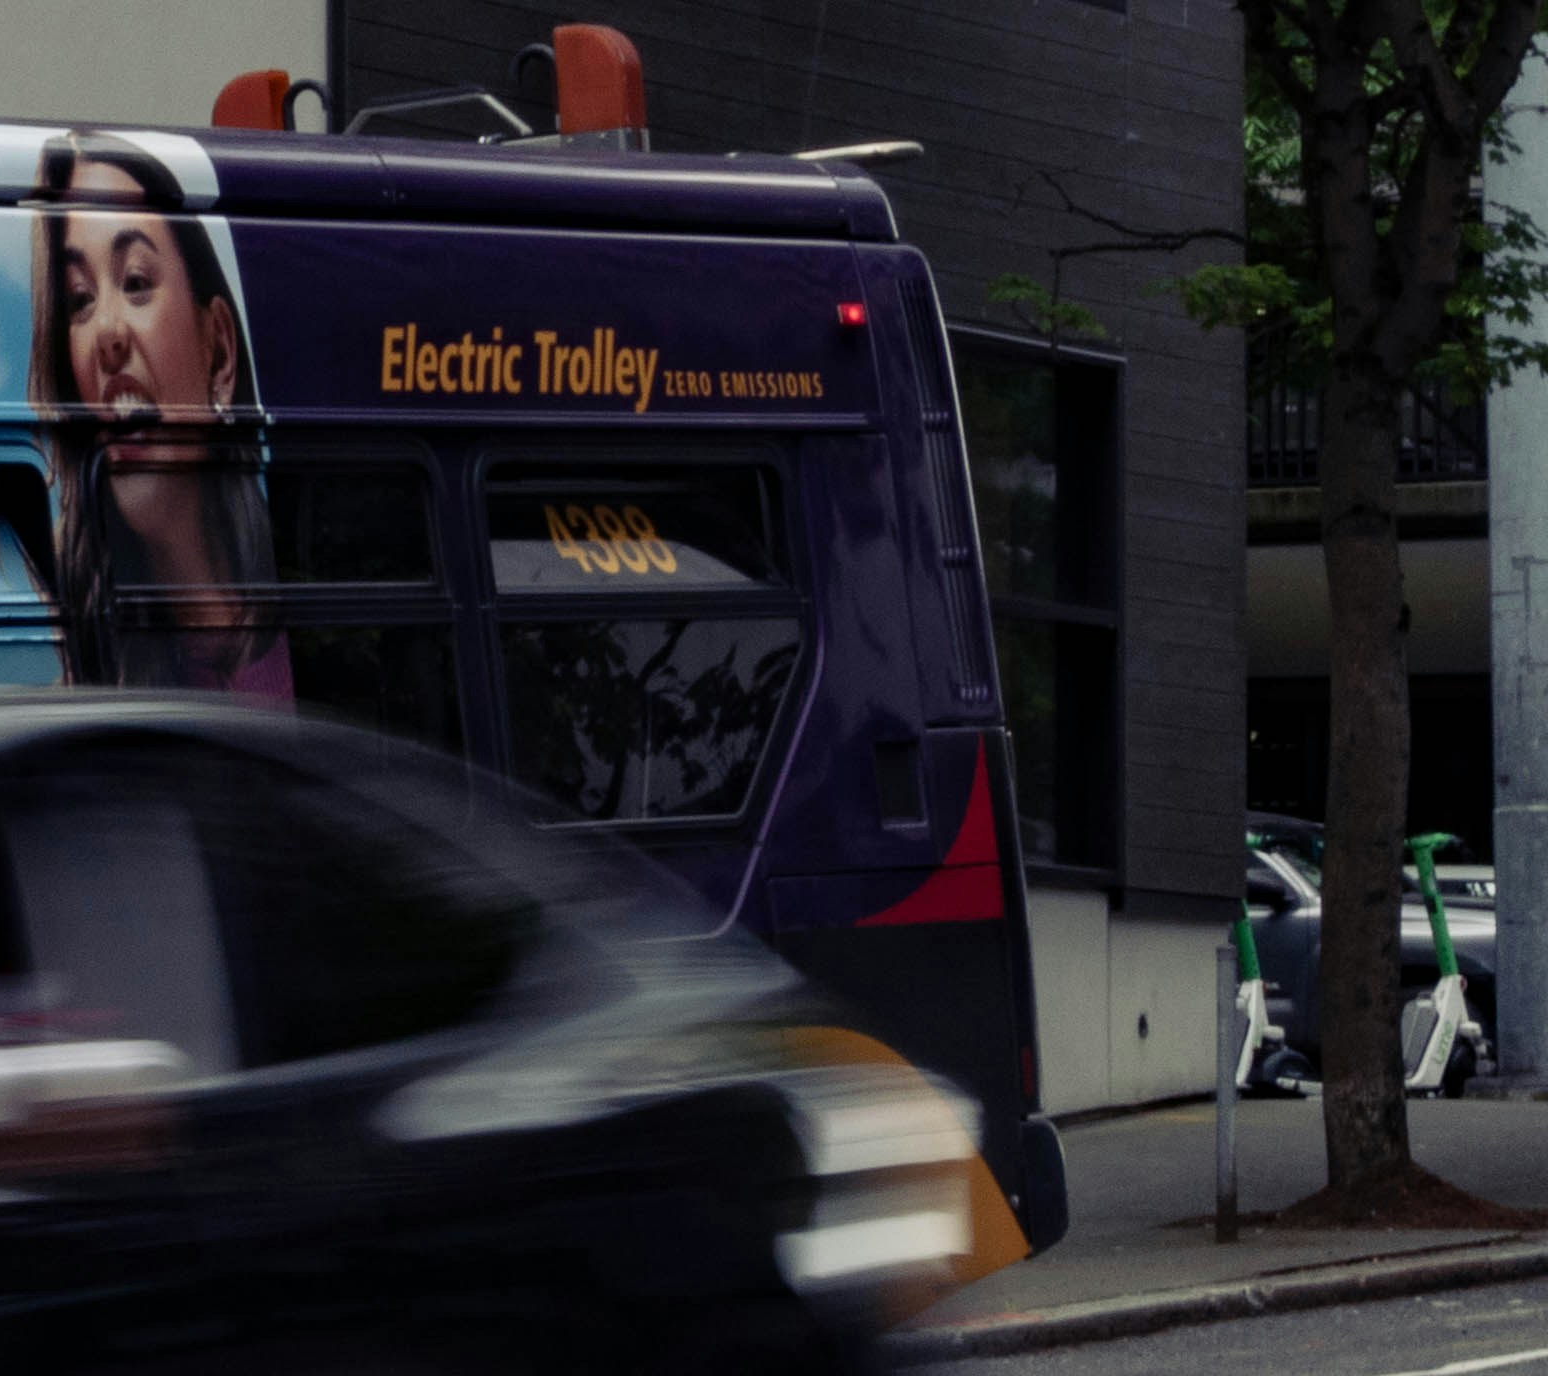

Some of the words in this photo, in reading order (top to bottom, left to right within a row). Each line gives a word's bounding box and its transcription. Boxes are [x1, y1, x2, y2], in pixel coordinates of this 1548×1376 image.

[381, 323, 523, 395] Electric
[534, 328, 658, 414] Trolley
[663, 370, 713, 399] ZERO
[720, 370, 825, 400] EMISSIONS
[543, 503, 678, 575] 4388
